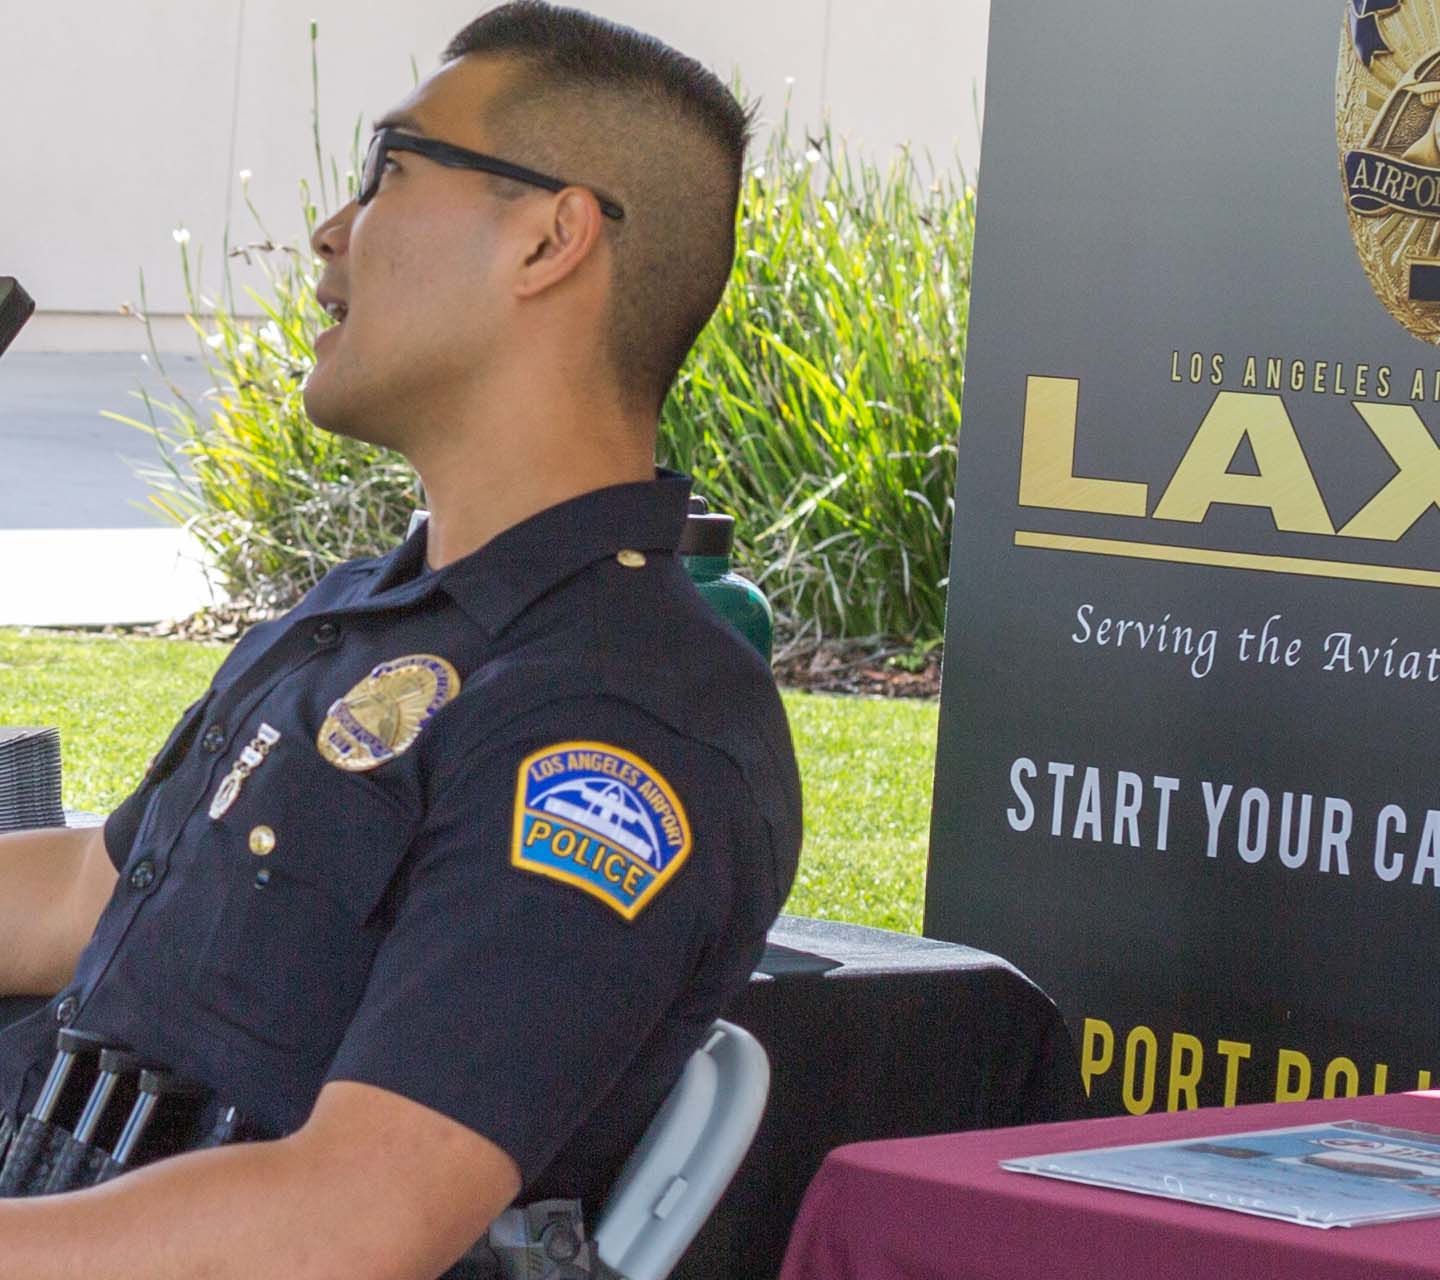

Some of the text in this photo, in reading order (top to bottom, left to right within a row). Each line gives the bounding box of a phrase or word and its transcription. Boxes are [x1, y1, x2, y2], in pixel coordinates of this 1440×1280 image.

[1170, 351, 1226, 387] LOS
[1242, 357, 1392, 398] ANGELES
[1072, 604, 1219, 678] Serving
[1238, 616, 1301, 669] the
[530, 753, 684, 846] LOS ANGELES AIRPORT
[1006, 756, 1180, 852] START
[1201, 780, 1350, 876] YOUR
[525, 819, 645, 896] POLICE
